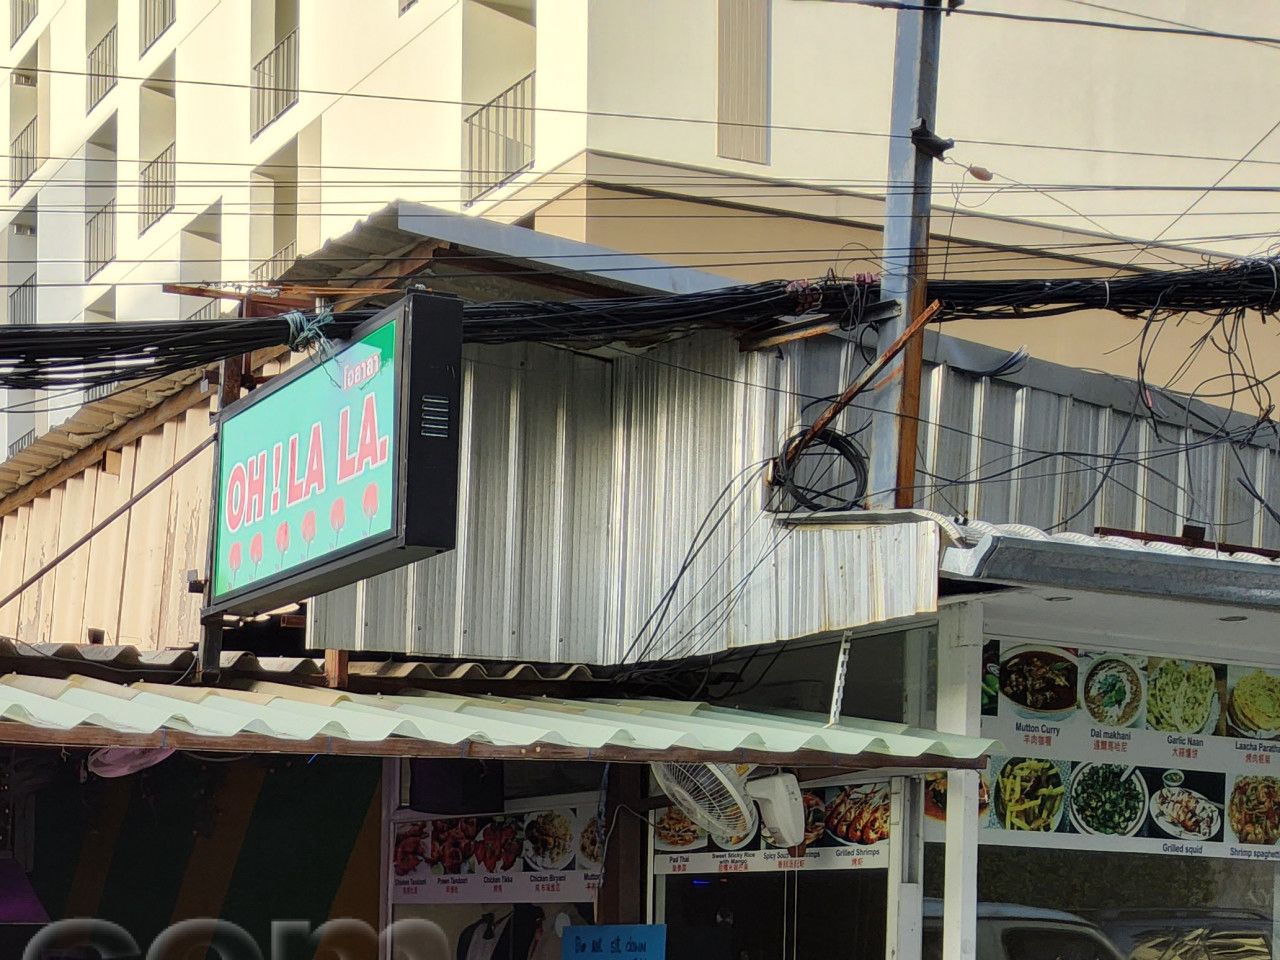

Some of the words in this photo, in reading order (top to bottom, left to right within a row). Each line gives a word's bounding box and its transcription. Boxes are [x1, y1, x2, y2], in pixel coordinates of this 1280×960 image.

[286, 422, 325, 508] LA
[1015, 721, 1039, 733] Mutton
[1041, 724, 1061, 737] Curry
[1167, 735, 1185, 745] Garlic
[1187, 737, 1204, 747] Naan
[835, 849, 855, 857] Grilled
[856, 848, 880, 857] Shrimps
[1162, 843, 1183, 853] Grilled
[1185, 845, 1203, 854] squid
[1230, 847, 1252, 857] Shrimp
[763, 852, 776, 860] Spicy
[483, 876, 501, 884] Chicken
